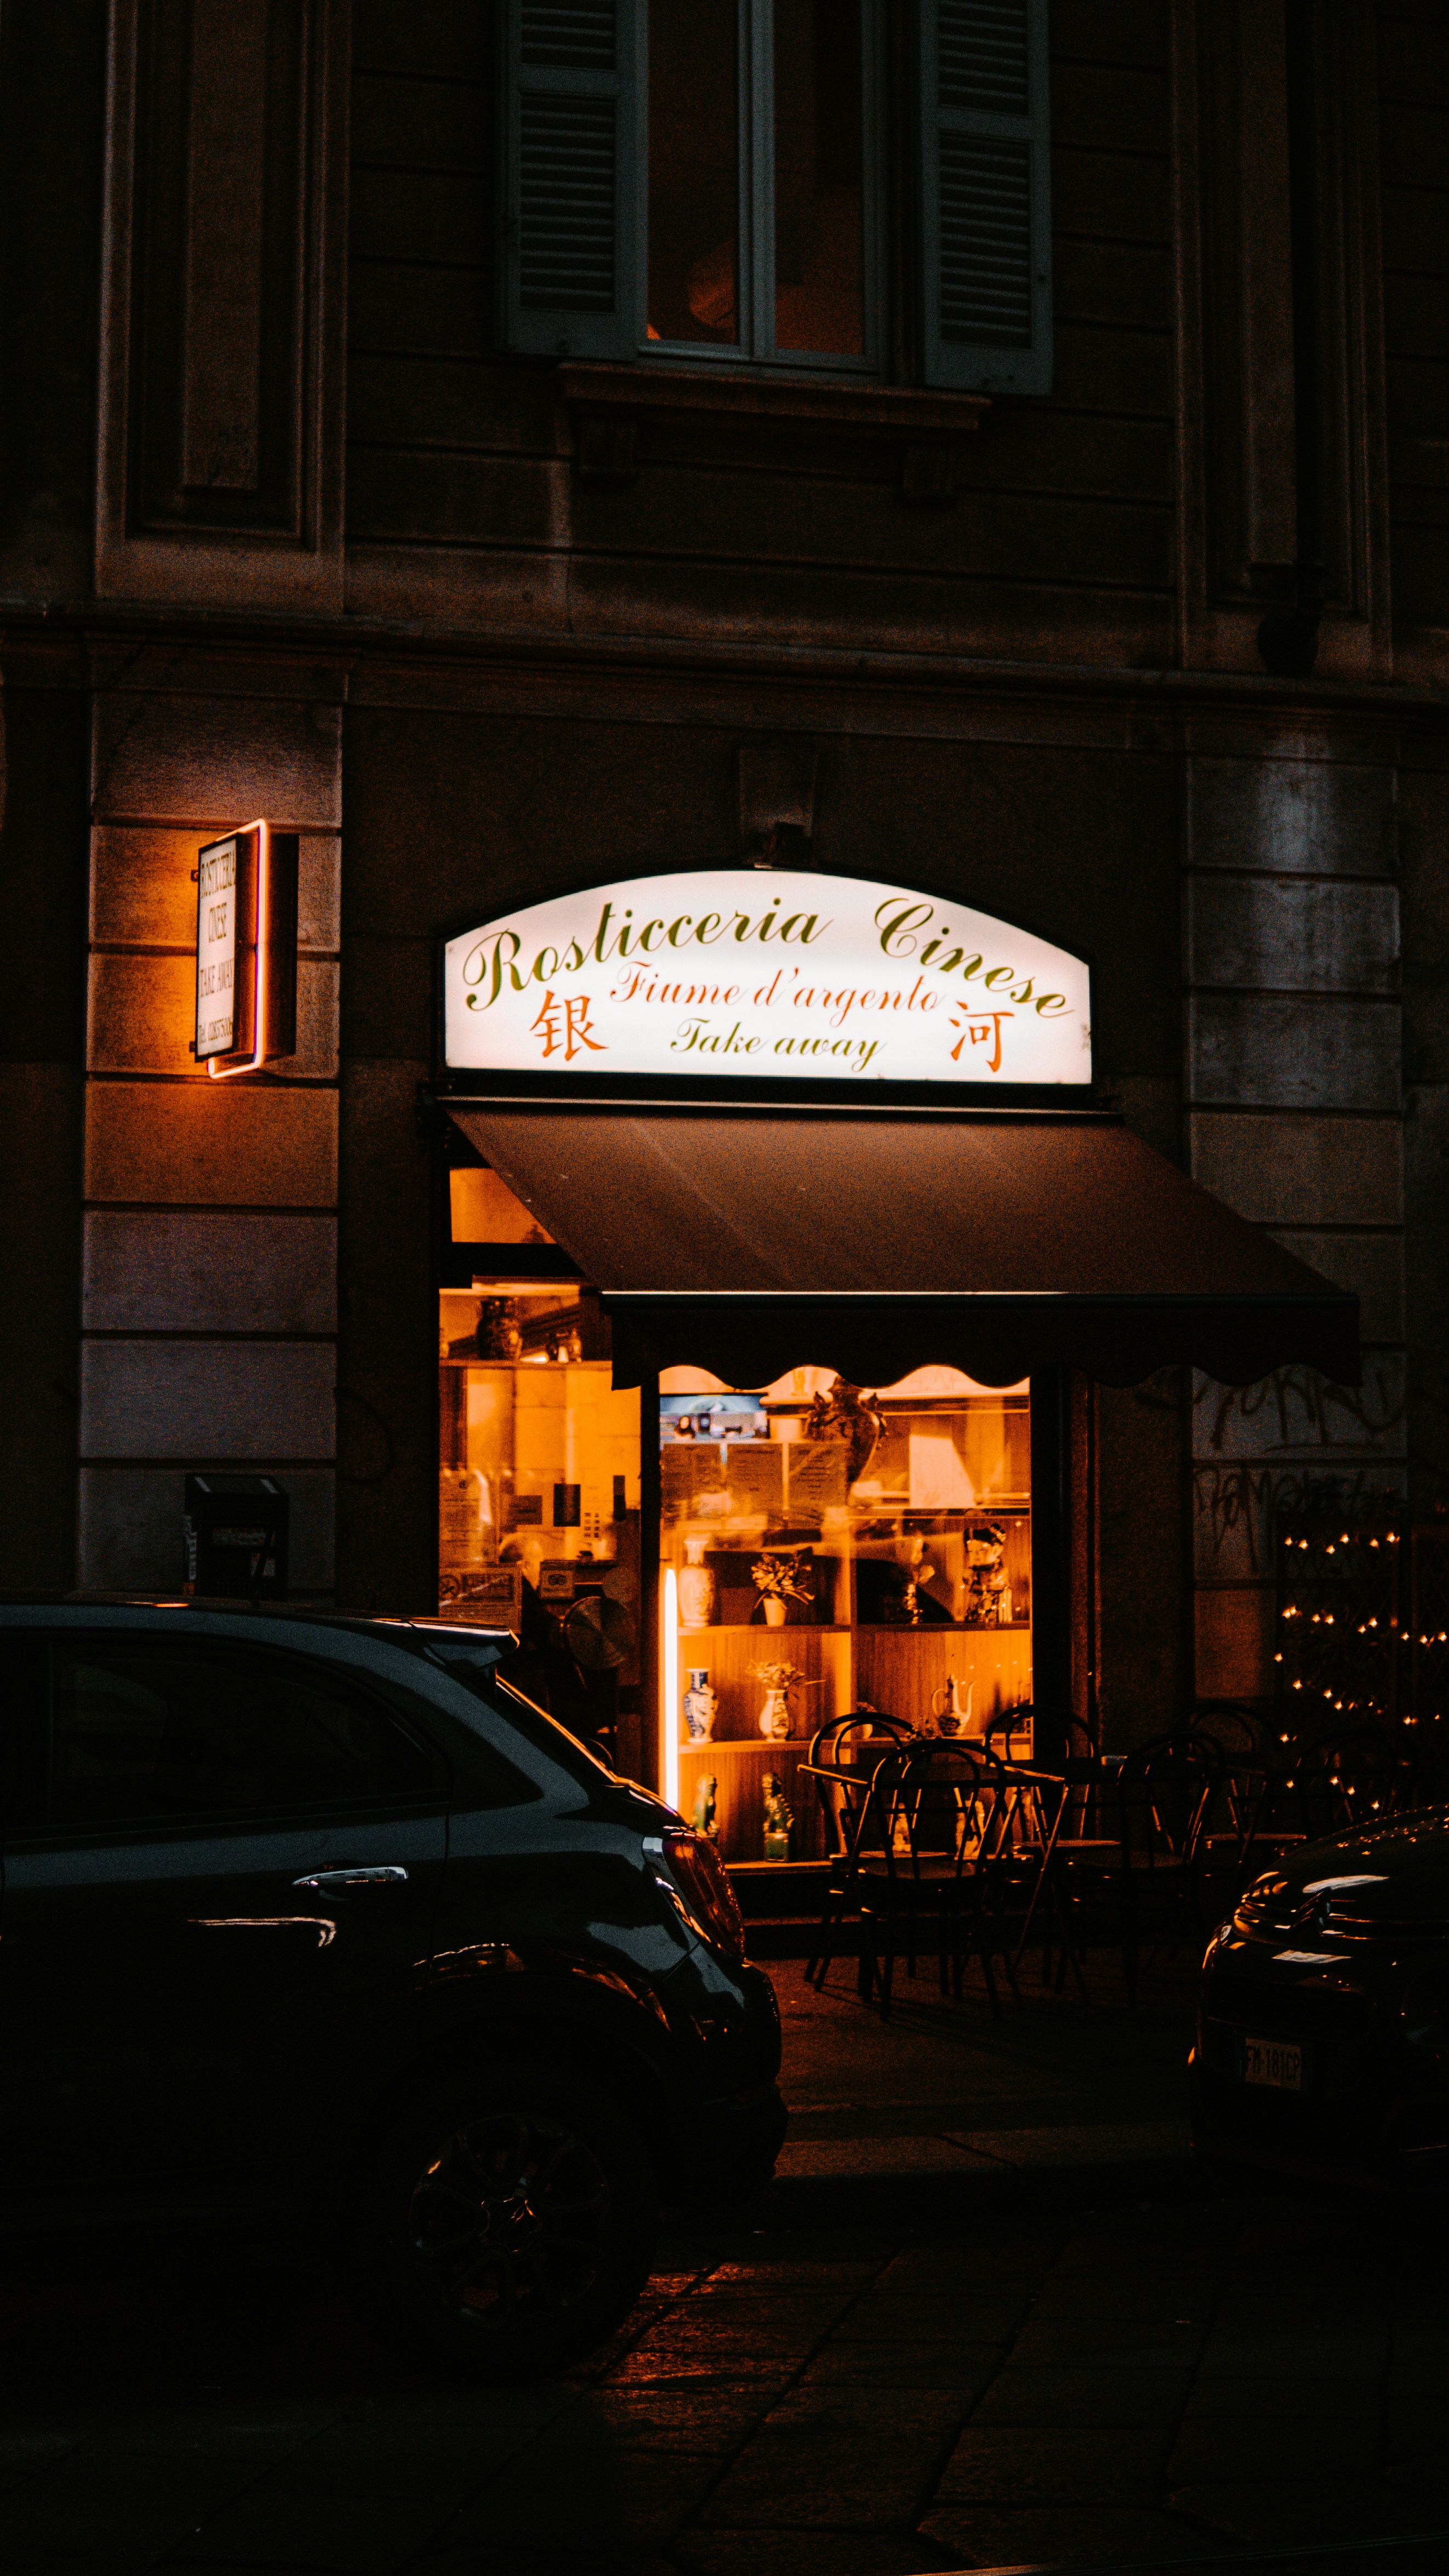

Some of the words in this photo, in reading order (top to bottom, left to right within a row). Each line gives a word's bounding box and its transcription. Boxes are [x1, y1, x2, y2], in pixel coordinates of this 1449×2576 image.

[200, 965, 215, 997] TAKE
[463, 897, 834, 1011] Rosticceria
[874, 897, 1075, 1017] Cinese
[610, 960, 749, 1006] Fiume
[529, 989, 609, 1062] 银
[948, 1001, 1015, 1073] 河
[670, 1017, 768, 1054] Take
[773, 1037, 888, 1073] away
